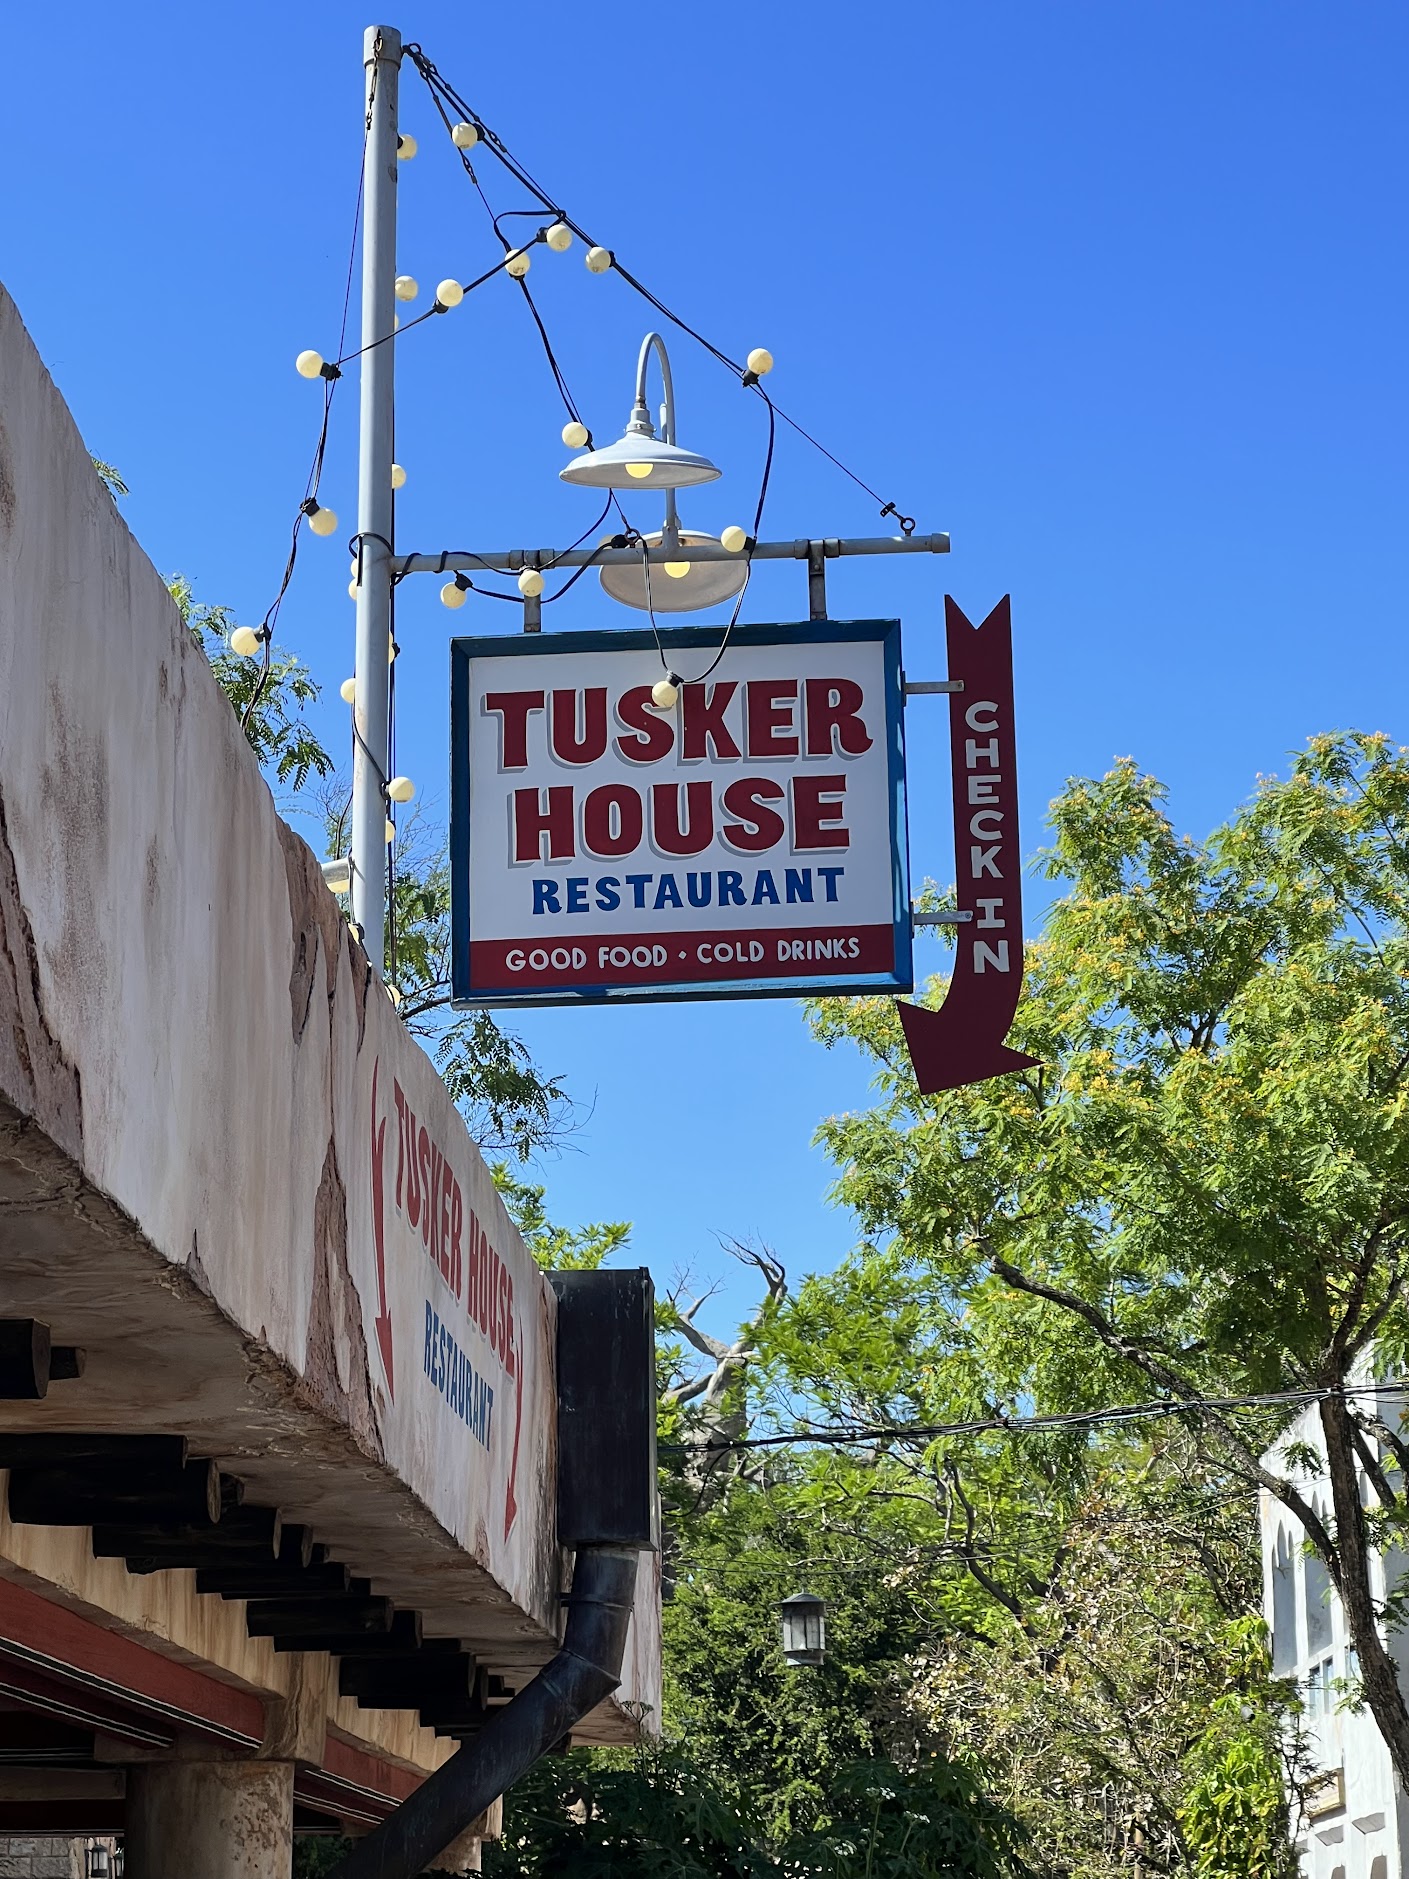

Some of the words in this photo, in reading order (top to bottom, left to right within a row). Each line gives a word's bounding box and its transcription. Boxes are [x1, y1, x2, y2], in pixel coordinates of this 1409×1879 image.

[483, 678, 874, 771] TUSKER
[509, 774, 850, 867] HOUSE
[965, 701, 1003, 879] CHECK
[532, 867, 845, 915] RESTAURANT
[974, 898, 1011, 974] IN
[505, 948, 587, 971] GOOD
[599, 944, 668, 969] FOOD
[697, 941, 764, 965] COLD
[777, 937, 860, 961] DRINKS
[393, 1076, 462, 1298] TUSKER
[467, 1207, 515, 1379] HOUSE
[423, 1299, 495, 1452] RESTAURANT
